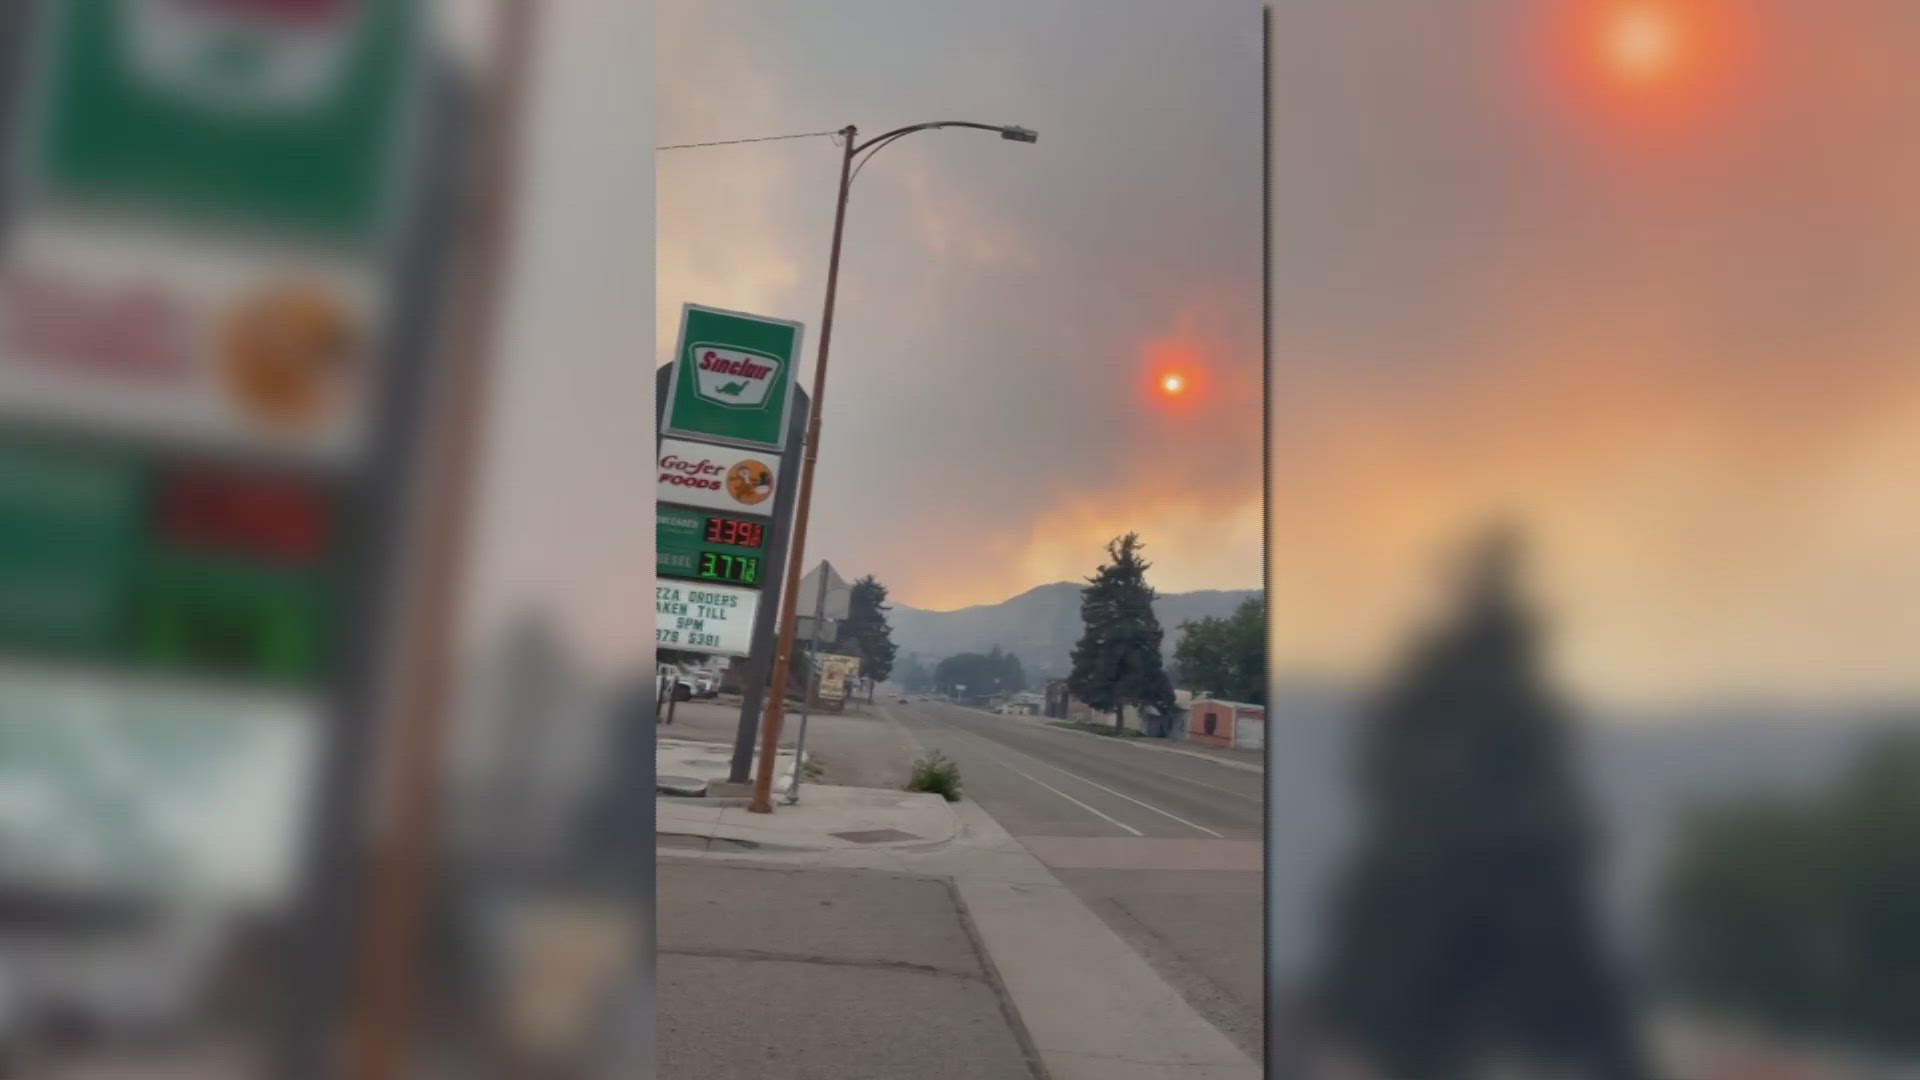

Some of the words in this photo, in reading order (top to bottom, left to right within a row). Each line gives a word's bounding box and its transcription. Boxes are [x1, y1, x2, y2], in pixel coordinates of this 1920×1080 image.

[699, 351, 773, 380] Sinclair
[660, 455, 726, 475] Go-fer
[659, 473, 721, 490] FOODS
[688, 591, 738, 608] ORDERS
[697, 605, 727, 620] TILL
